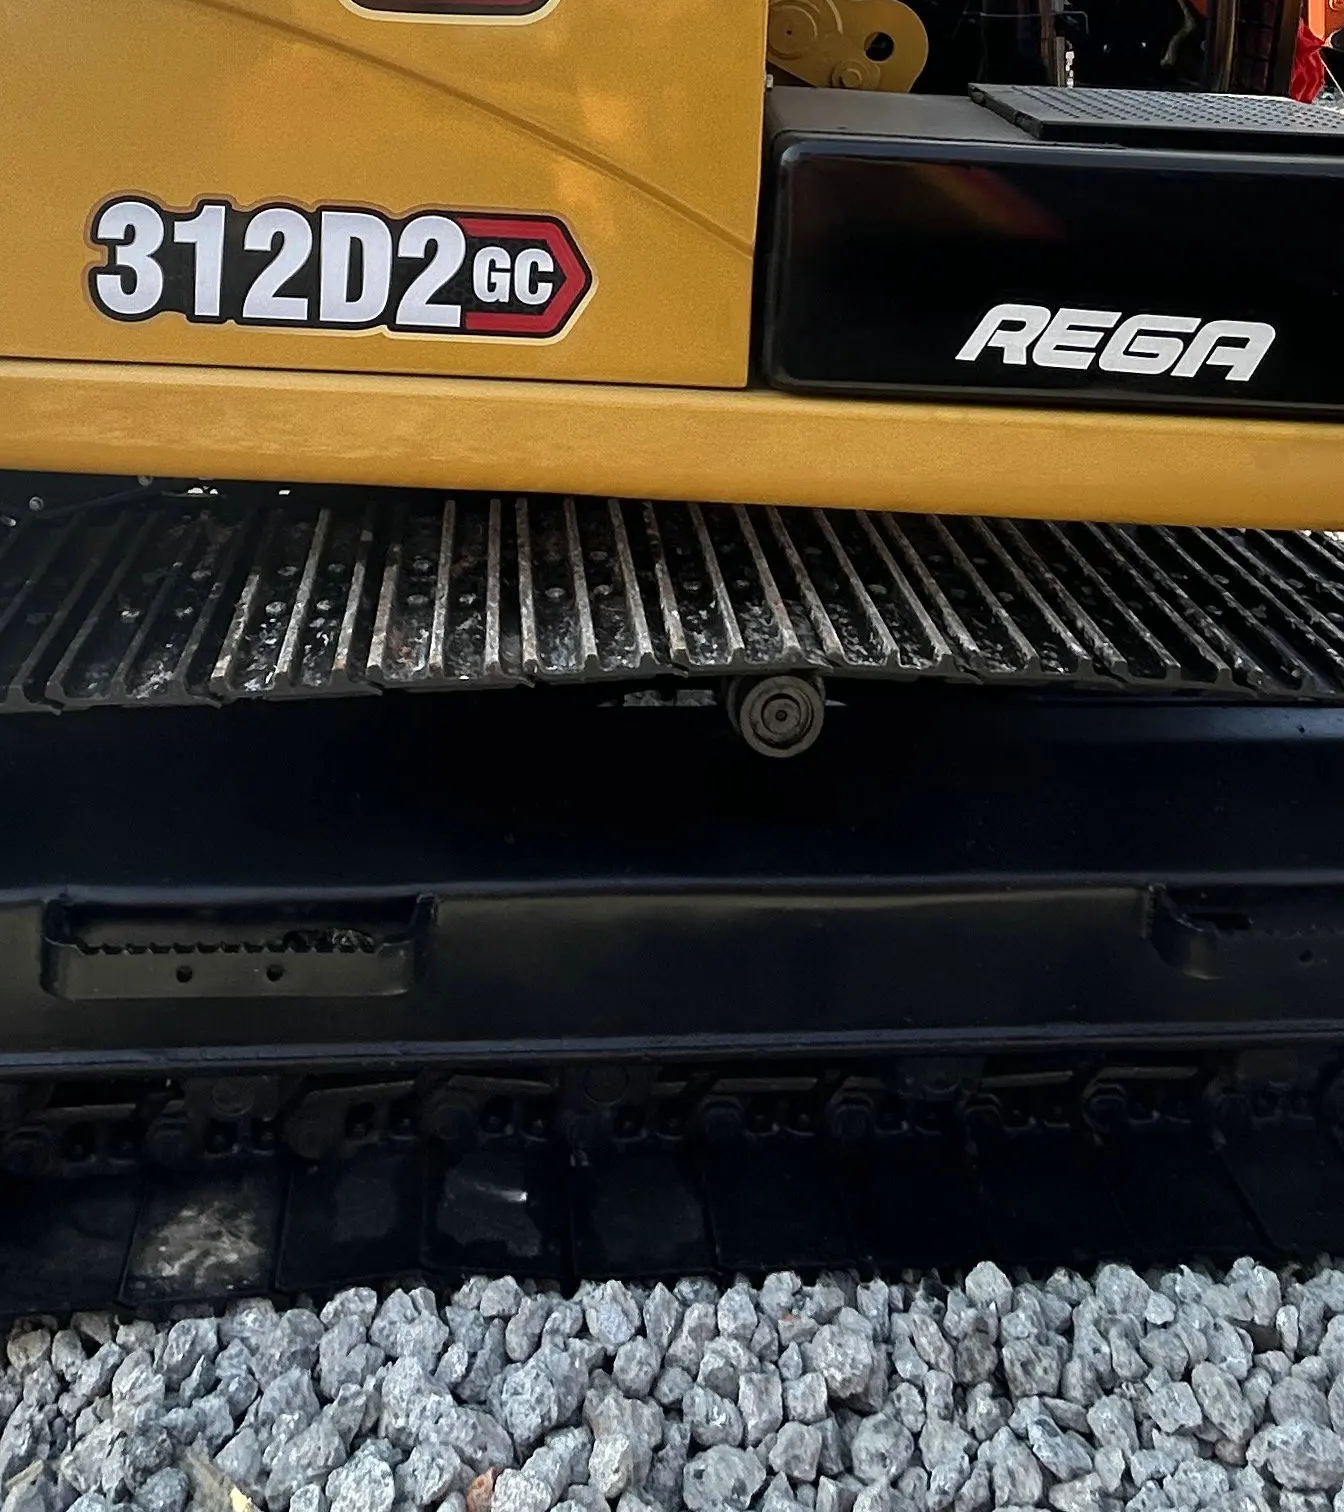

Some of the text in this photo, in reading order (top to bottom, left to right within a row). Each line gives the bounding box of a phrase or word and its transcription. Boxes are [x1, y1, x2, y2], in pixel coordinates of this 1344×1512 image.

[95, 200, 555, 329] 312D2 GC
[955, 303, 1276, 381] REGA
